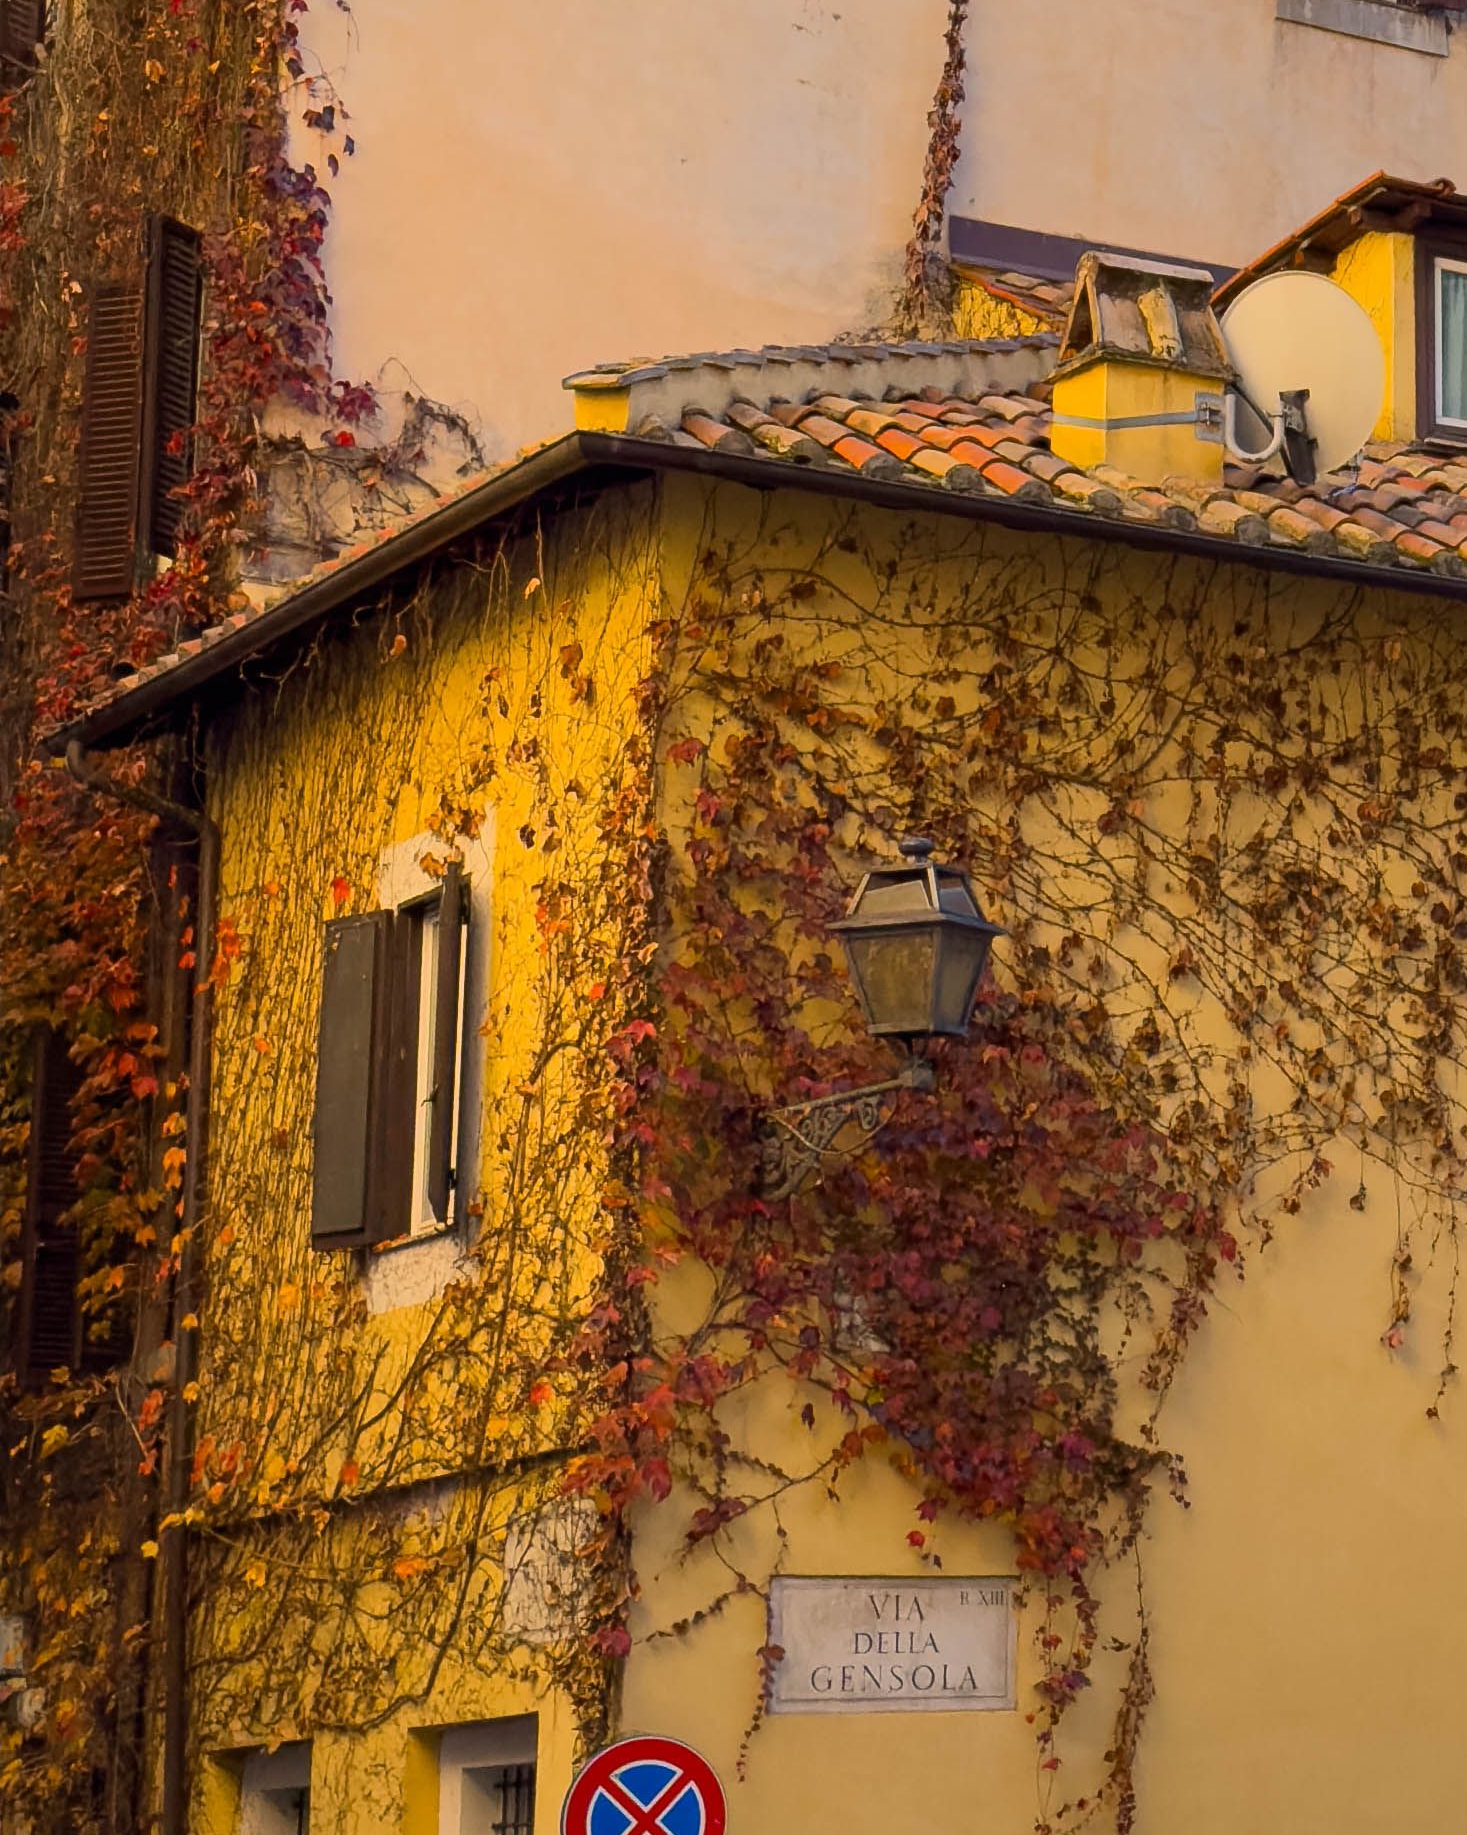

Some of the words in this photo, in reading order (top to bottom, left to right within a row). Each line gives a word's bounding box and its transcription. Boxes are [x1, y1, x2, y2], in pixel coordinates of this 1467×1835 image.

[868, 1594, 925, 1622] VIA
[853, 1631, 940, 1655] DELLA
[810, 1664, 978, 1694] GENSOLA
